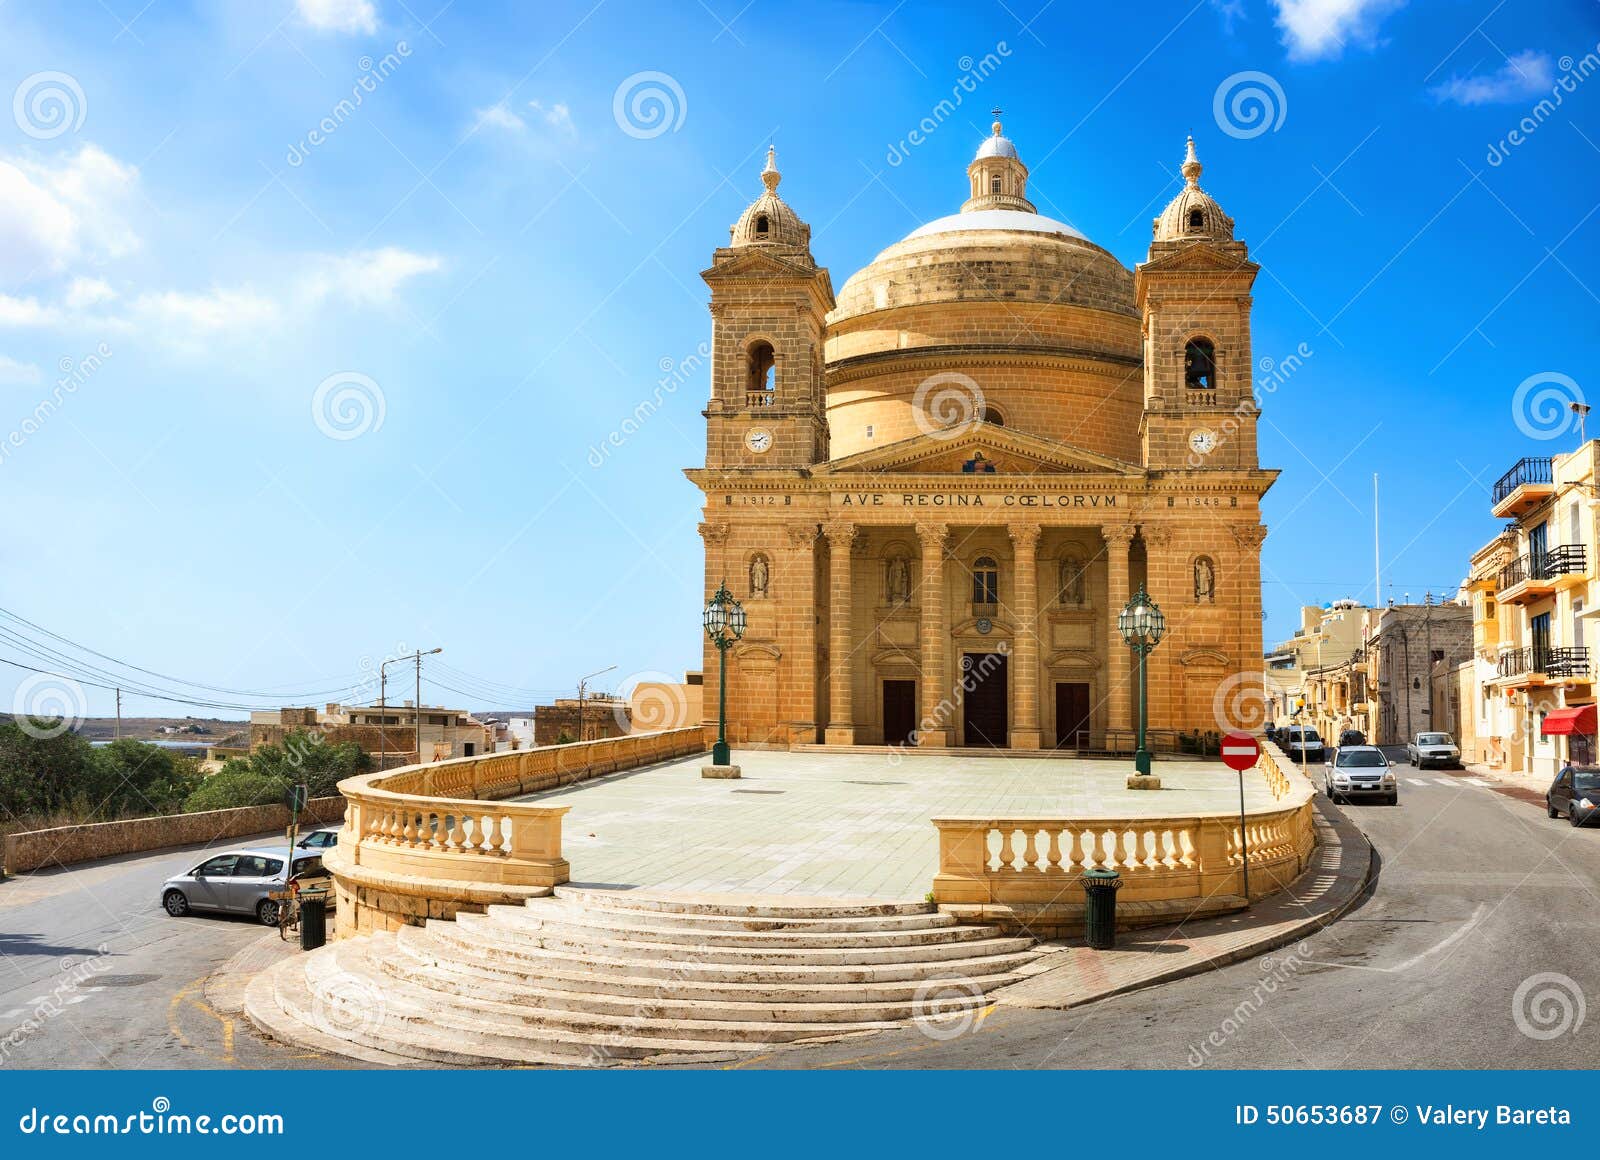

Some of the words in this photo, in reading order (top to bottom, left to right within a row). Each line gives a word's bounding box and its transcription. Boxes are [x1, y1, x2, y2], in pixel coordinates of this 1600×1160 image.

[842, 494, 885, 506] AVE
[902, 494, 984, 506] REGINA
[1185, 497, 1219, 506] 1948
